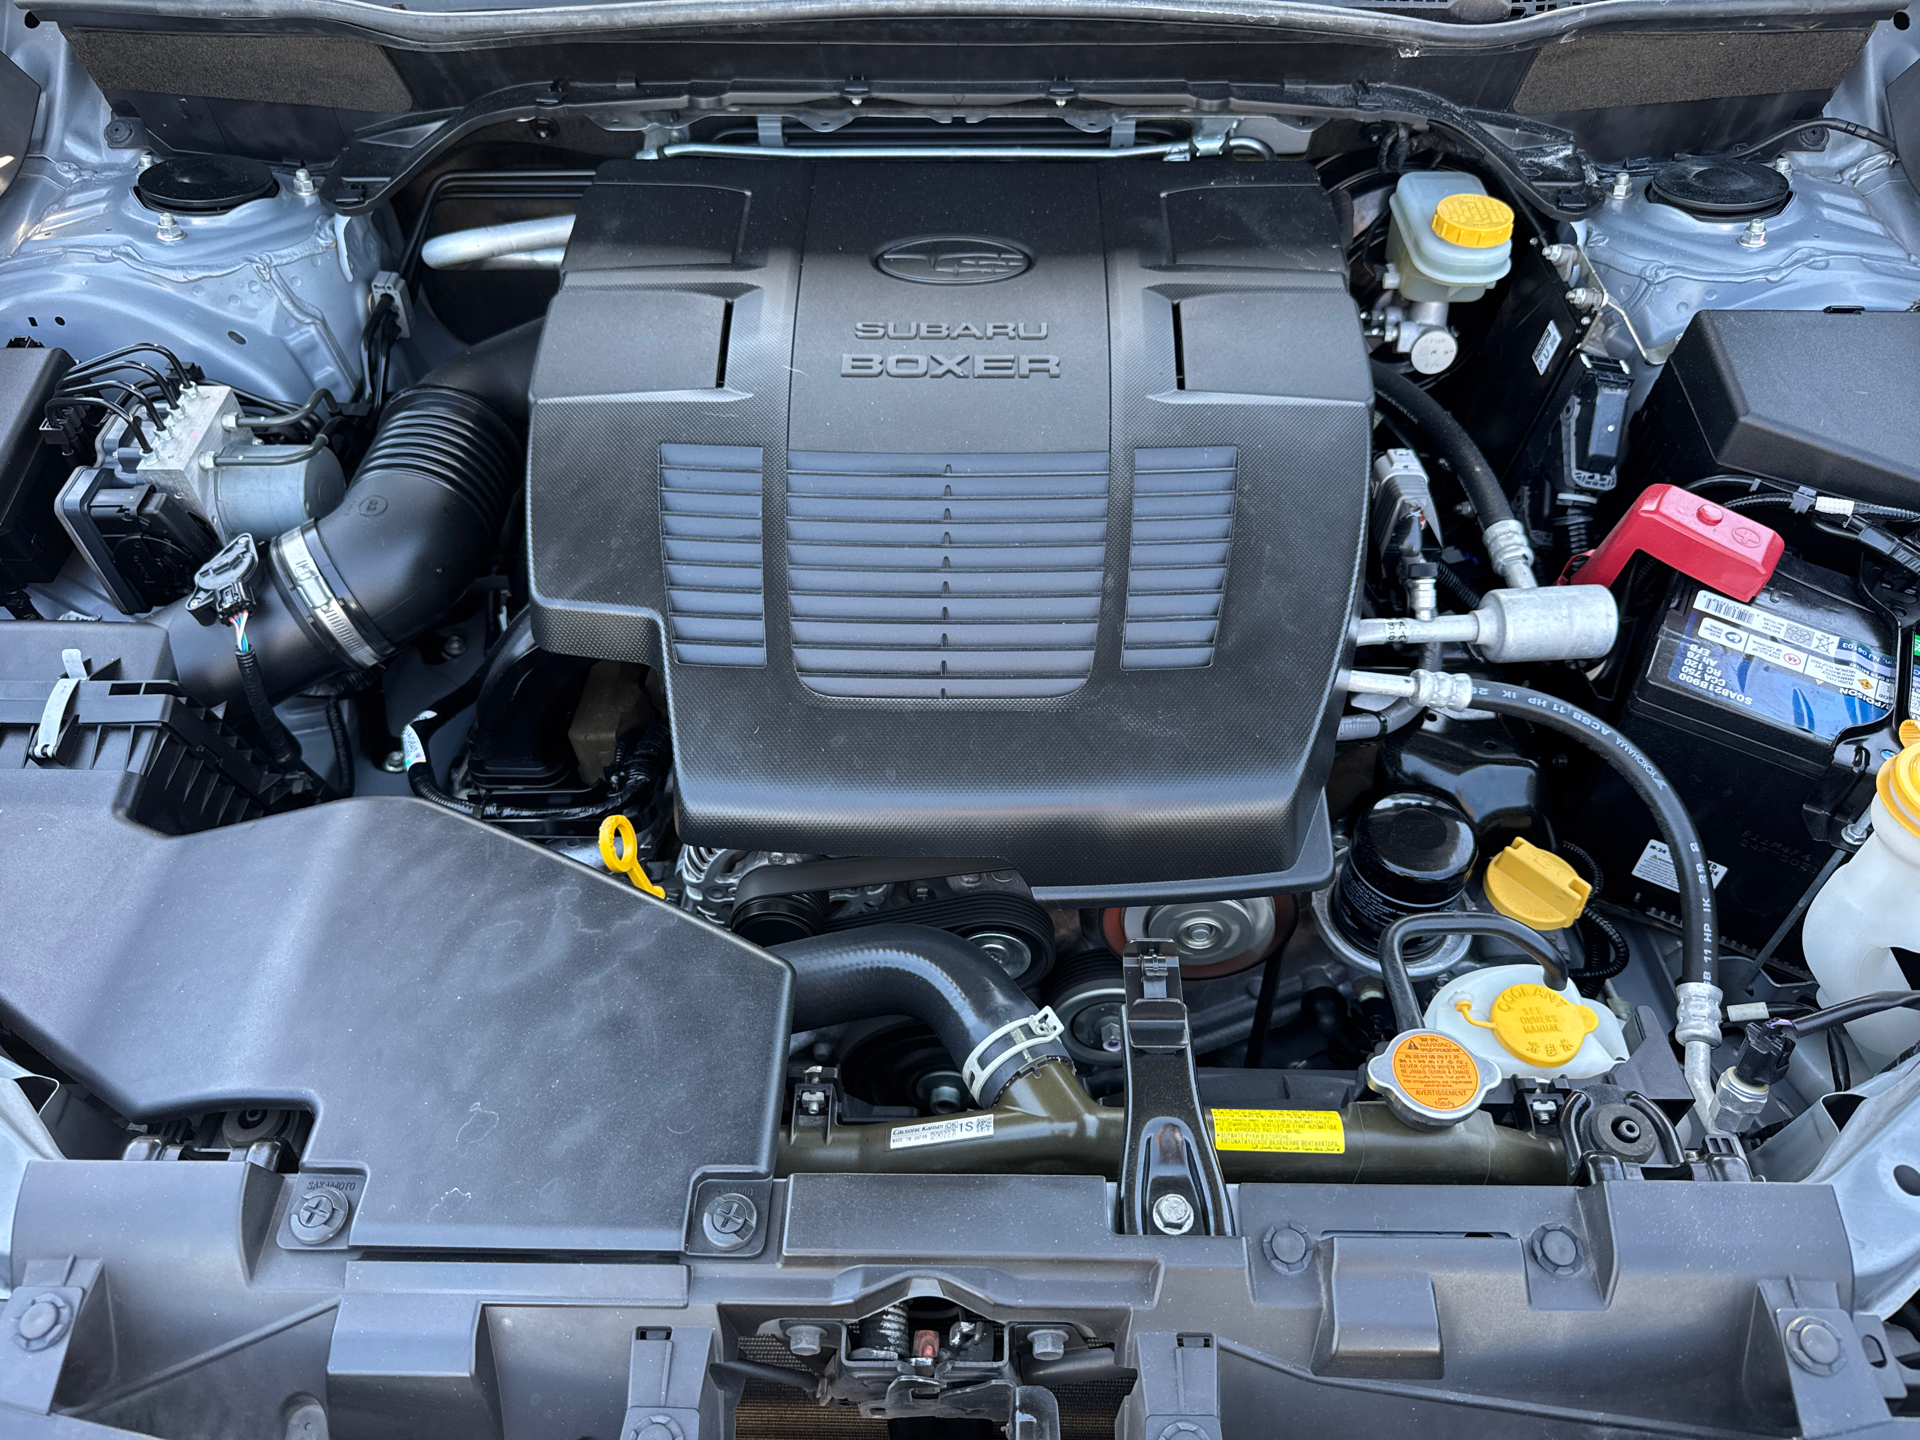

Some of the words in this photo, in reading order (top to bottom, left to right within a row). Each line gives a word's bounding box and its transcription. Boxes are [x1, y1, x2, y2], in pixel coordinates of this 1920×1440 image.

[855, 322, 1048, 340] SUBARU
[840, 353, 1061, 379] BOXER
[1690, 644, 1710, 656] EFB
[1684, 658, 1704, 668] 120
[1703, 657, 1718, 667] Ah
[1868, 654, 1880, 662] NJ
[1681, 666, 1702, 678] 750
[1706, 666, 1722, 678] RC
[1704, 673, 1726, 687] CCA
[1528, 698, 1547, 708] HP
[1552, 704, 1568, 714] 11
[1616, 736, 1657, 778] YOKOHAMA
[1704, 923, 1712, 942] HP
[1498, 986, 1568, 1012] COOLANT
[1522, 1006, 1541, 1015] SEE
[1523, 1024, 1562, 1034] MANUAL
[959, 1122, 974, 1132] 1S
